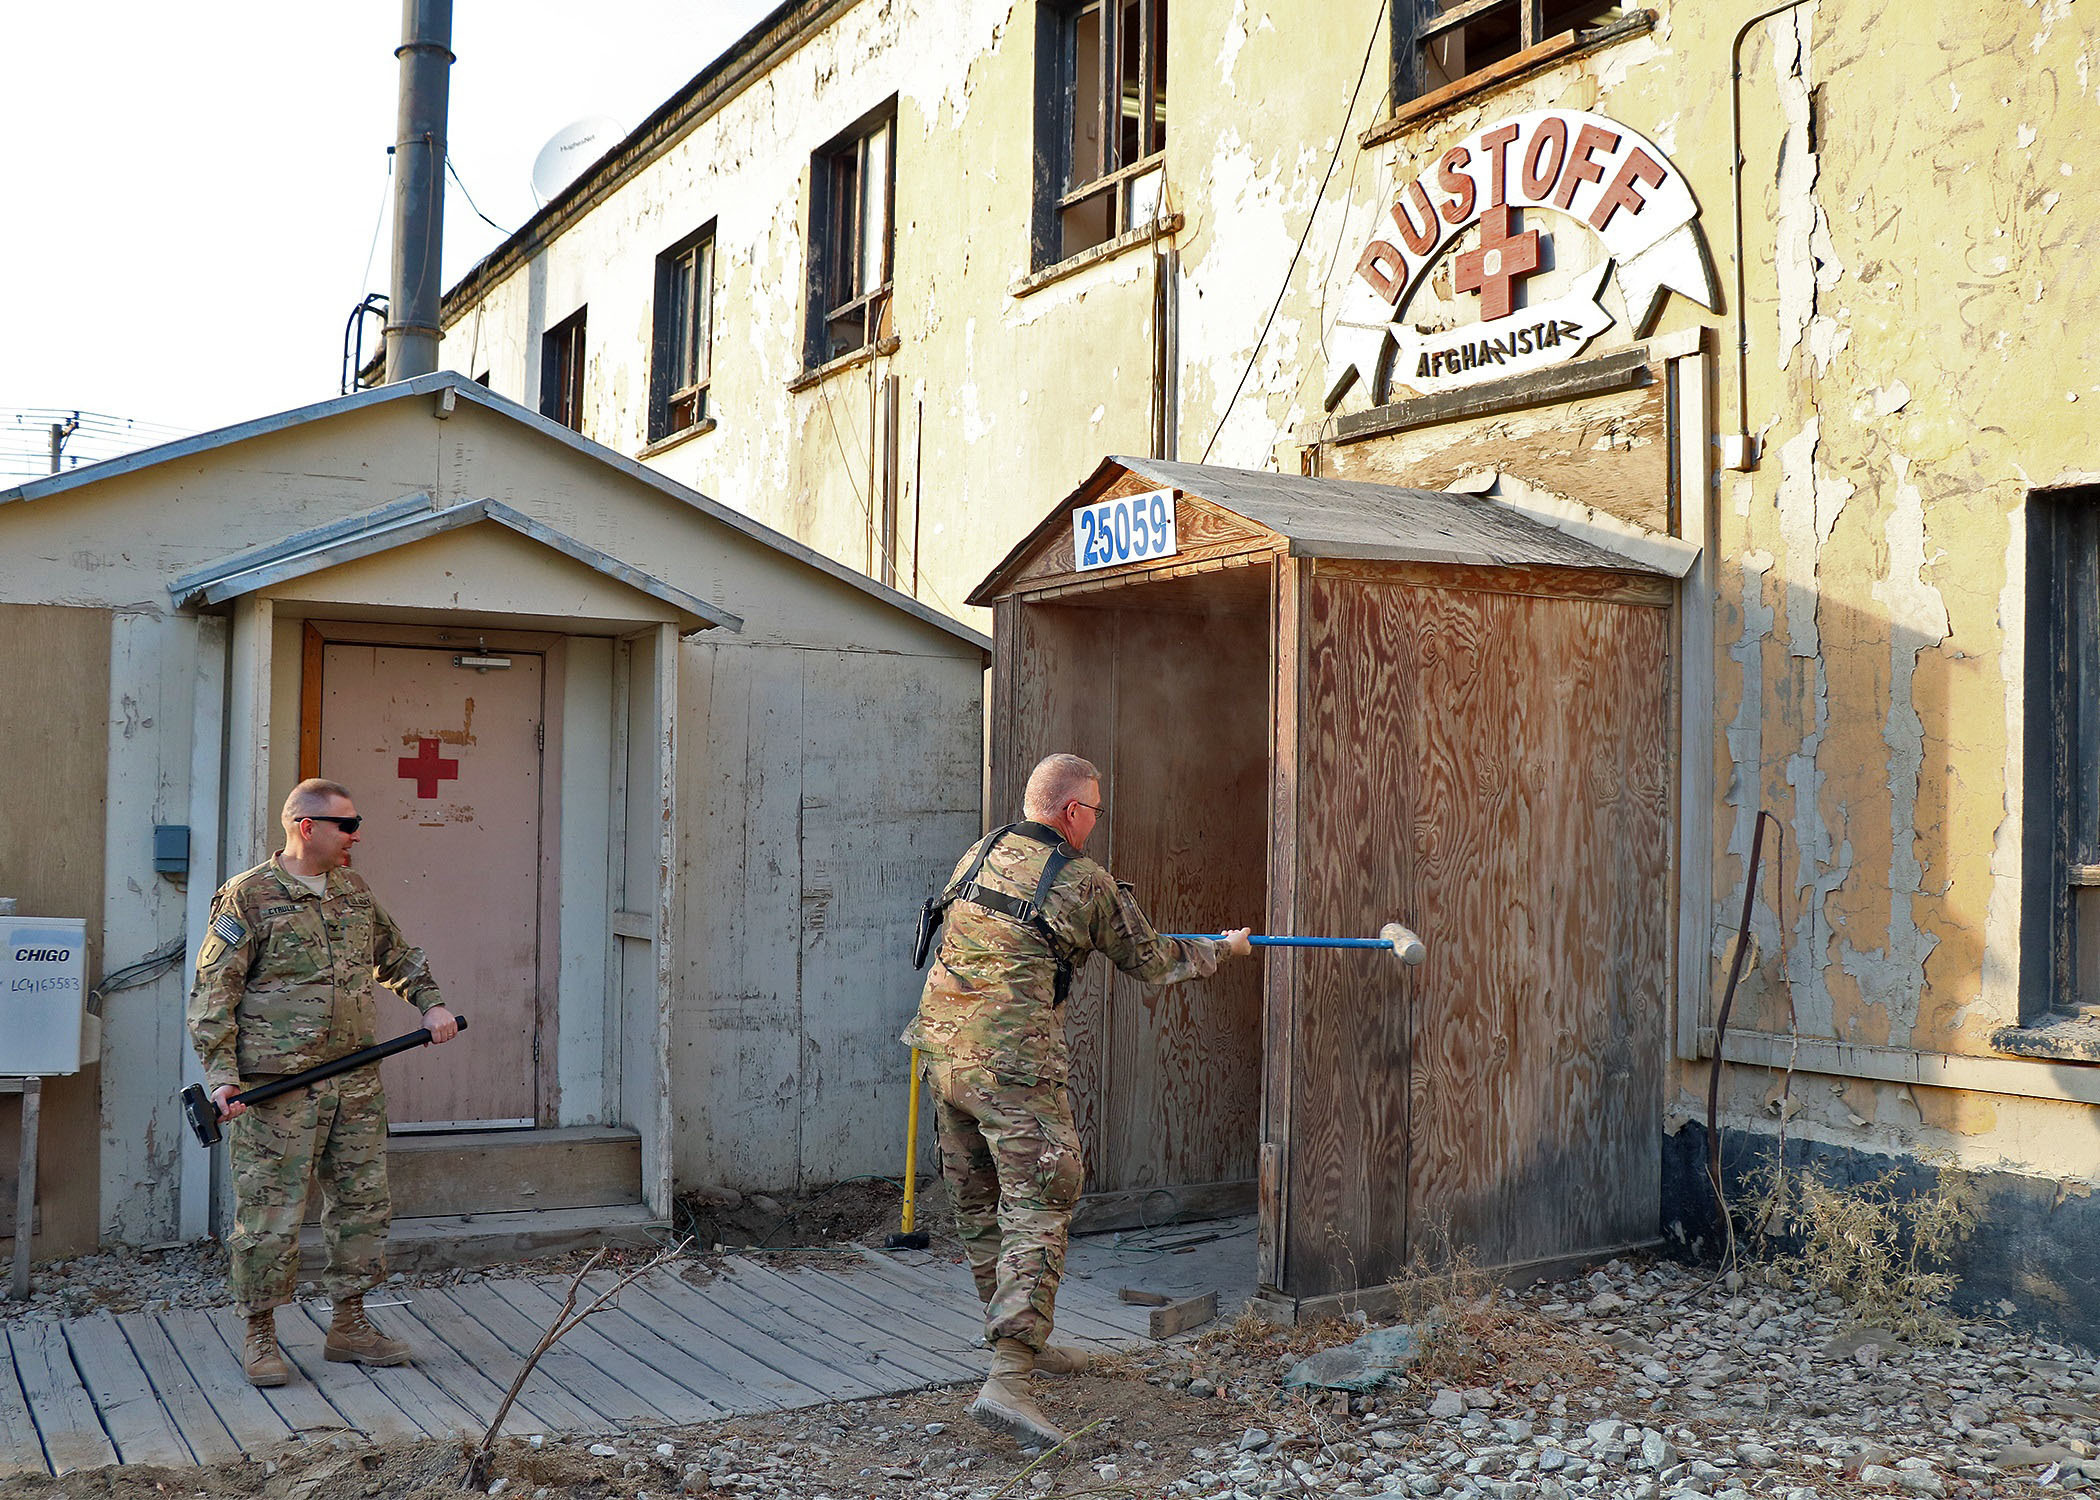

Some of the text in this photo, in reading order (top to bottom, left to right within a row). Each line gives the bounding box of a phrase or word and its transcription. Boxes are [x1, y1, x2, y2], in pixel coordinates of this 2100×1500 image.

[1357, 117, 1668, 306] DUSTOFF
[1081, 494, 1167, 567] 25059
[15, 948, 71, 962] CHIGO
[11, 978, 80, 993] LC4165583
